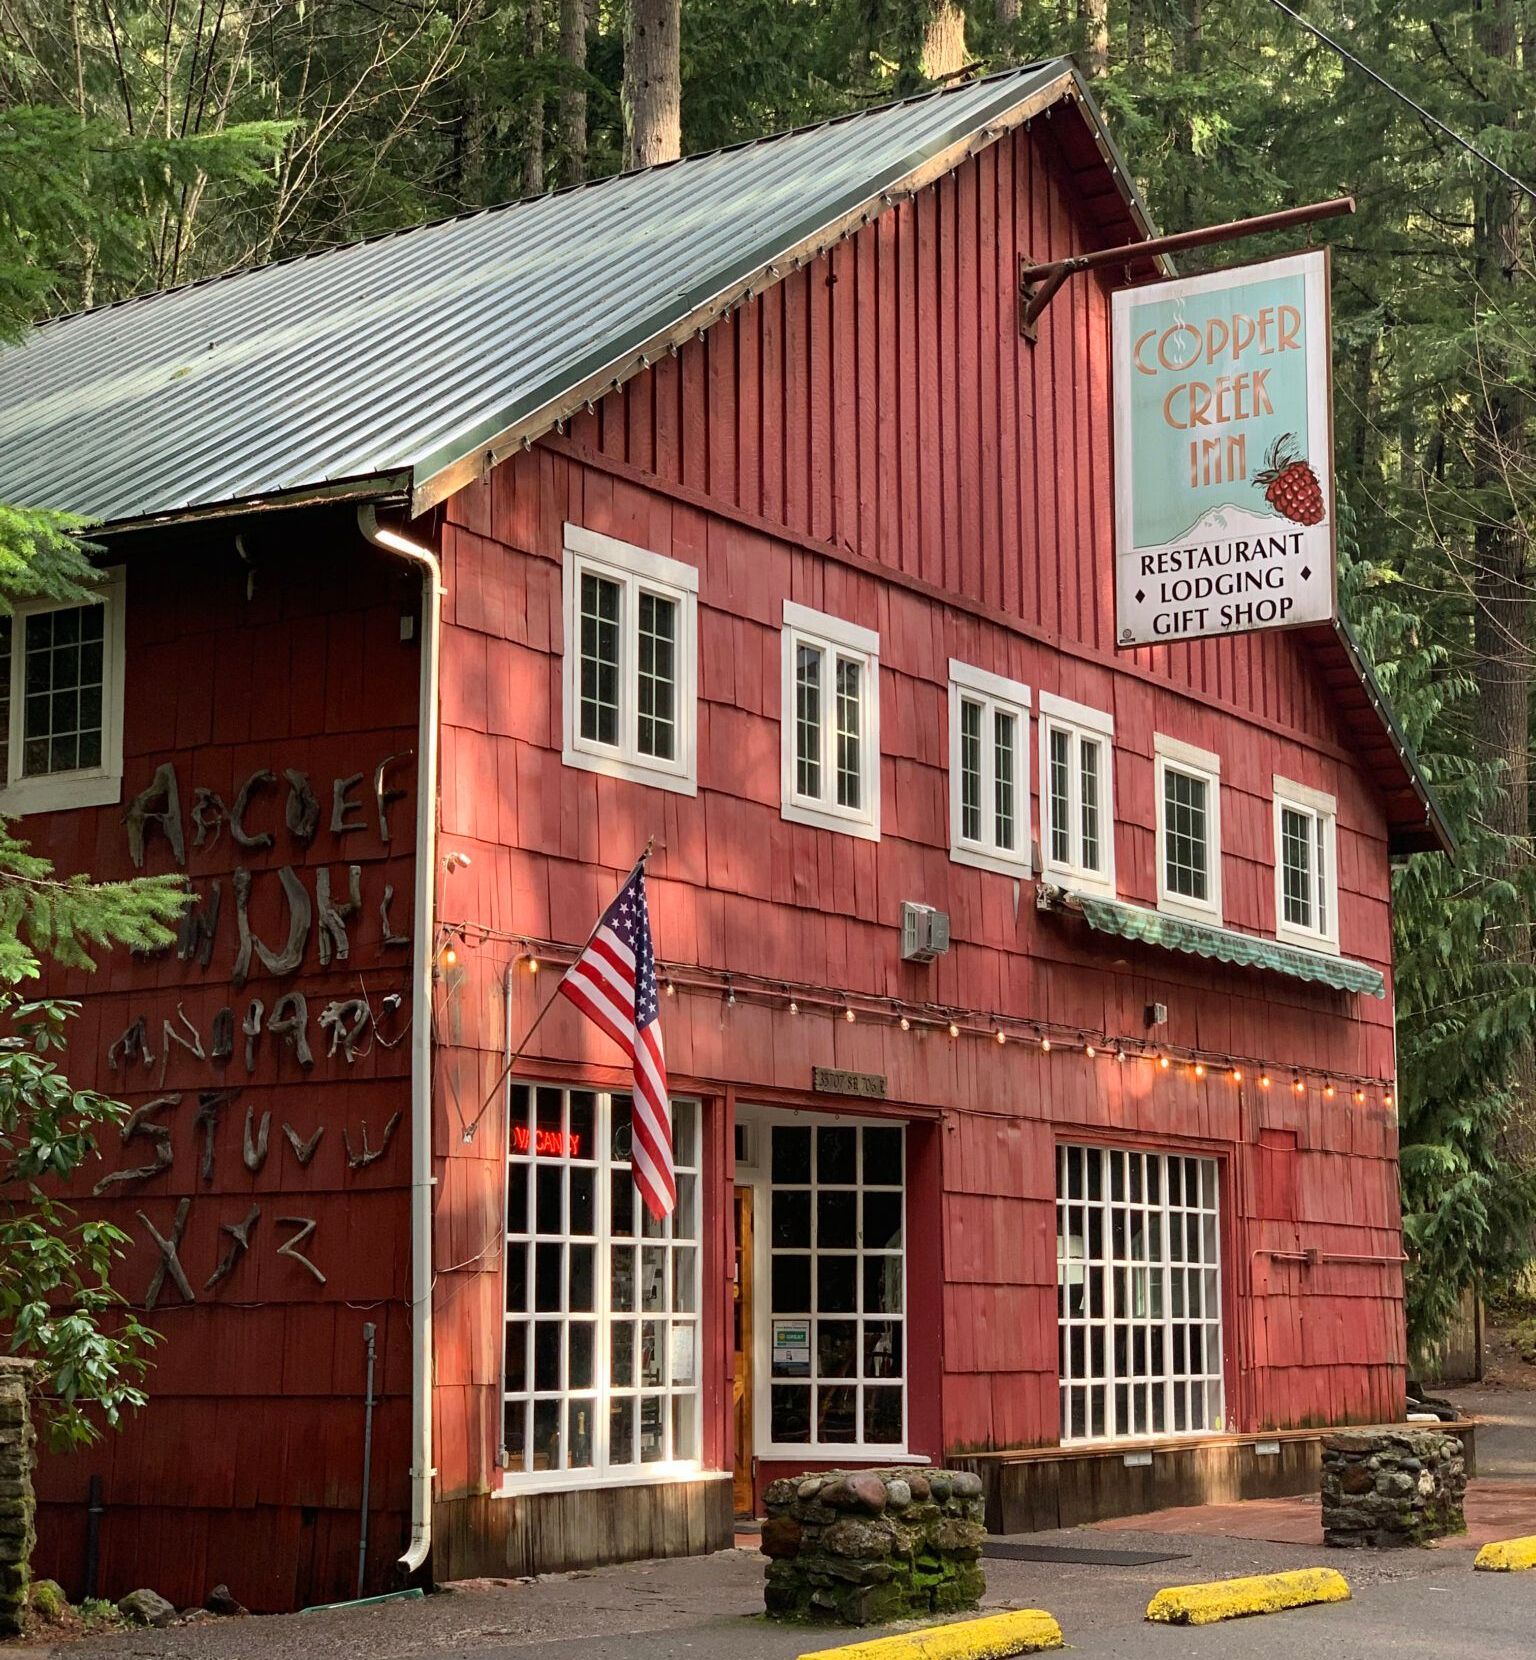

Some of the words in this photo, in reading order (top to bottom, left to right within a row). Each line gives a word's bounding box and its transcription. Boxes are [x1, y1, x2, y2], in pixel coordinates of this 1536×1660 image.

[1133, 304, 1302, 376] COPPER
[1163, 367, 1274, 430] CREEK
[1190, 432, 1247, 489] INN
[1140, 532, 1305, 577] RESTAURANT
[1160, 566, 1285, 604] LODGING
[1152, 607, 1209, 636] GIFT
[1219, 596, 1294, 628] SHOP
[514, 1126, 580, 1155] VCANY
